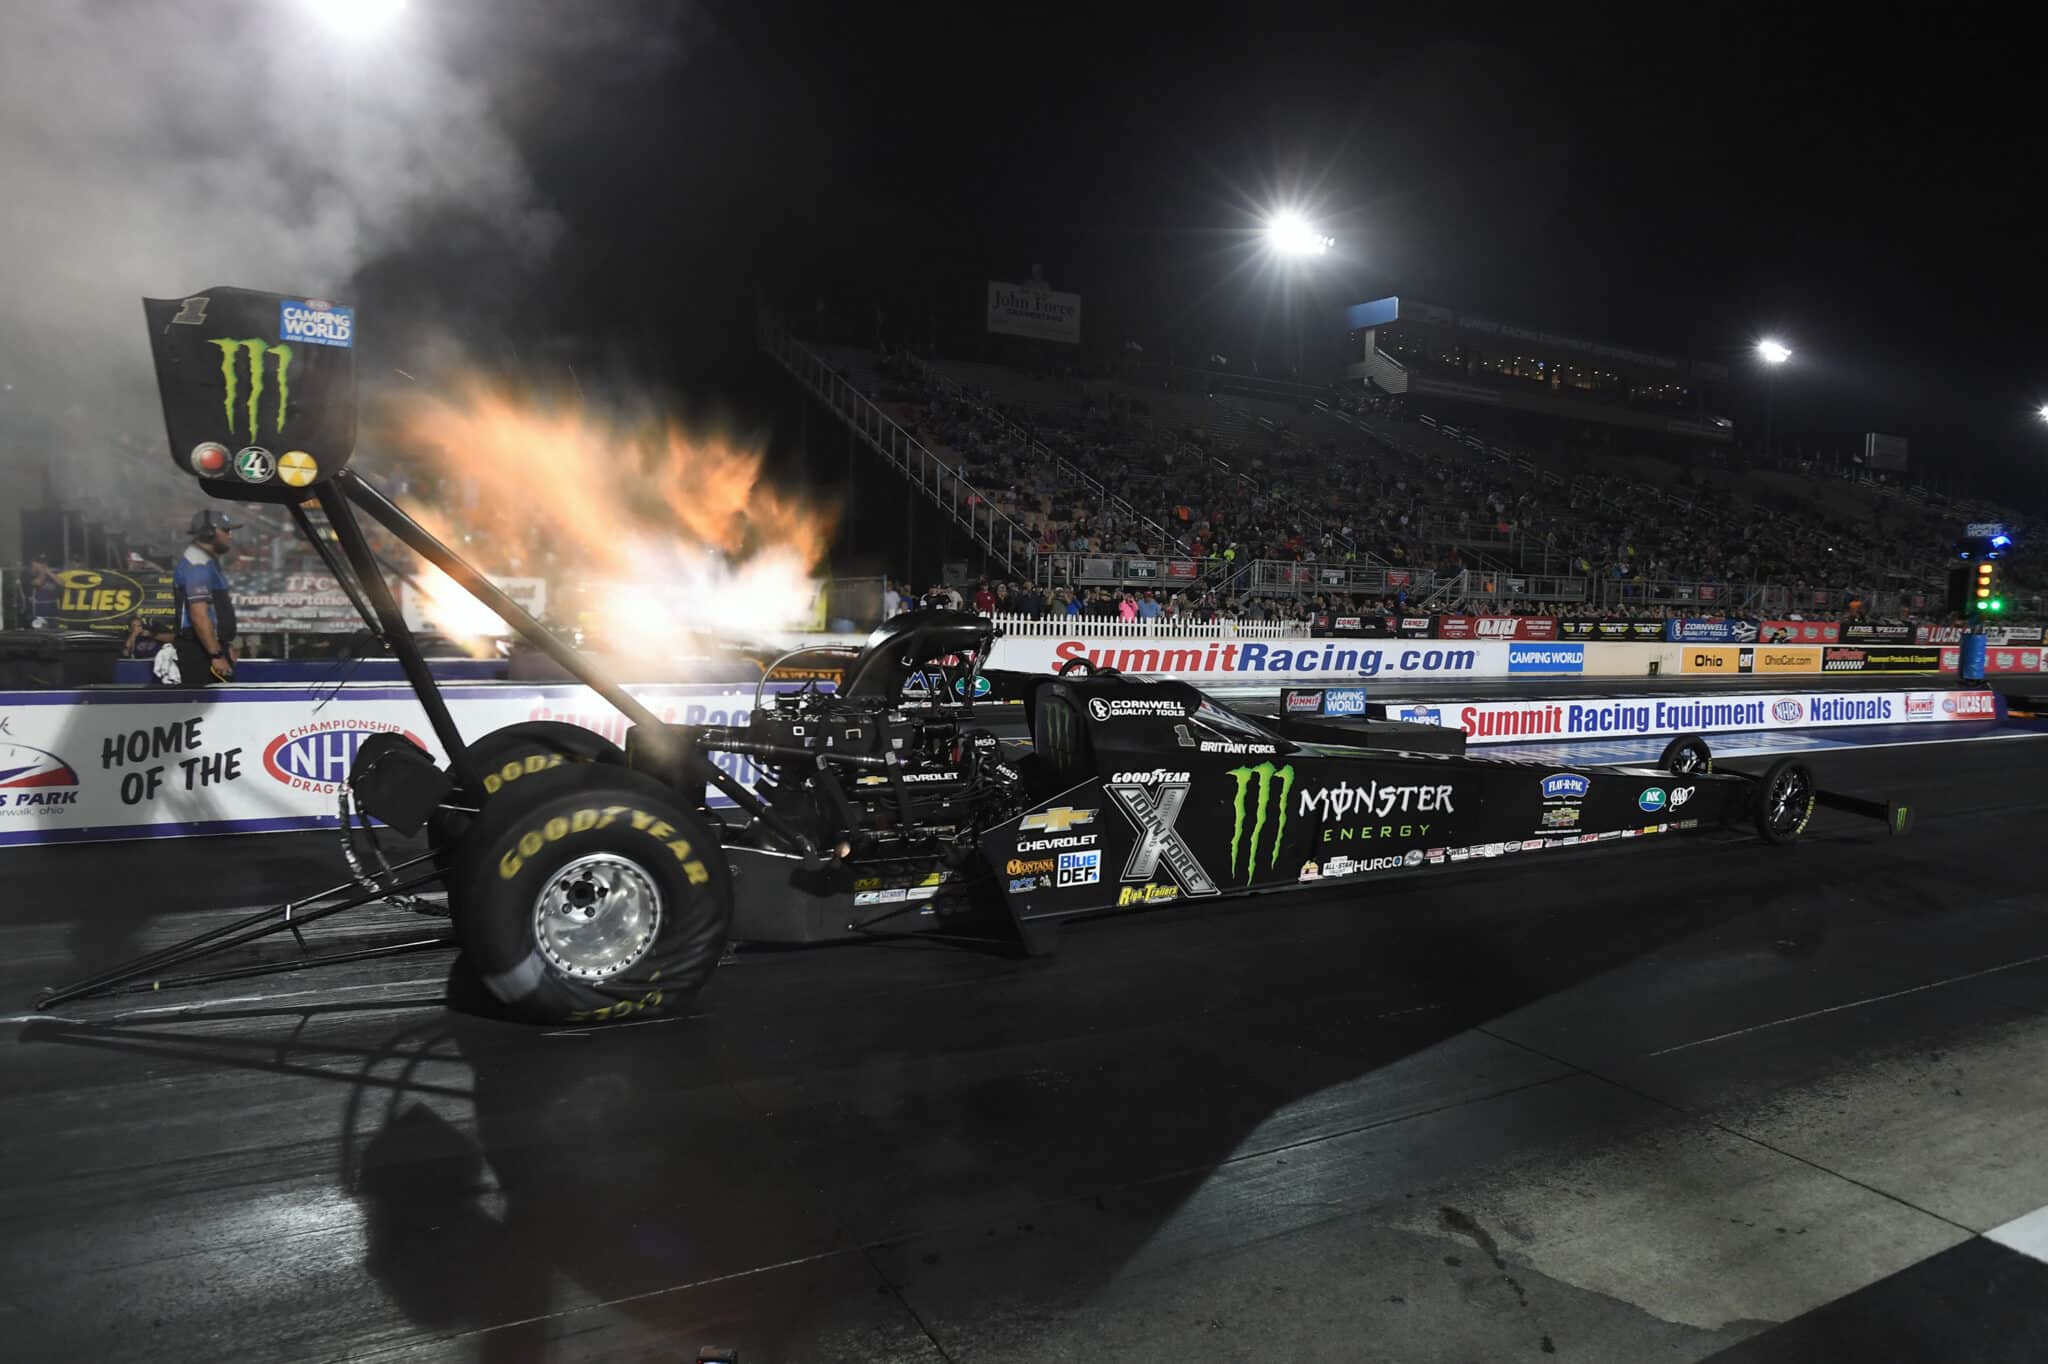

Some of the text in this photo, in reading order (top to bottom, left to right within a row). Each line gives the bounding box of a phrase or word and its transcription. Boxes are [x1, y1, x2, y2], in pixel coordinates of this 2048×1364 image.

[172, 297, 210, 325] 1
[283, 307, 351, 327] CAMPING
[284, 319, 351, 340] WORLD
[58, 588, 132, 611] LLIES
[1685, 623, 1728, 631] CORNWELL
[1929, 626, 1962, 642] LUCAS
[1051, 640, 1475, 677] SummitRacing.com
[1510, 651, 1583, 664] CAMPING WORLD
[1694, 654, 1723, 667] Ohio
[1764, 655, 1812, 666] OhioCat.com
[1286, 692, 1320, 707] SUMMIT
[1326, 691, 1364, 701] CAMPING
[1957, 696, 1981, 713] LUCAS
[1110, 700, 1186, 710] CORNWELL
[1110, 708, 1186, 717] QUALITY TOOLS
[1326, 700, 1364, 712] WORLD
[1460, 705, 1562, 738] Summit
[1568, 703, 1650, 733] Racing
[1655, 701, 1765, 731] Equipment
[1810, 696, 1892, 721] Nationals
[289, 719, 401, 739] CHAMPIONSHIP
[102, 716, 204, 770] HOME
[974, 736, 997, 748] MSD
[1200, 740, 1277, 755] BRITTANY FORCE
[120, 747, 243, 805] OF THE
[902, 771, 960, 783] EVROLET
[995, 763, 1019, 781] MSD
[1111, 769, 1191, 786] GOODYEAR
[291, 778, 335, 795] DRAG
[16, 791, 79, 807] PARK
[39, 806, 65, 816] ohio
[1126, 792, 1204, 887] JOHN FORCE
[1323, 824, 1431, 842] ENERGY
[1017, 834, 1099, 853] CHEVROLET
[1060, 854, 1097, 869] Blue
[1353, 854, 1403, 873] HURCO
[1059, 866, 1097, 885] DEF
